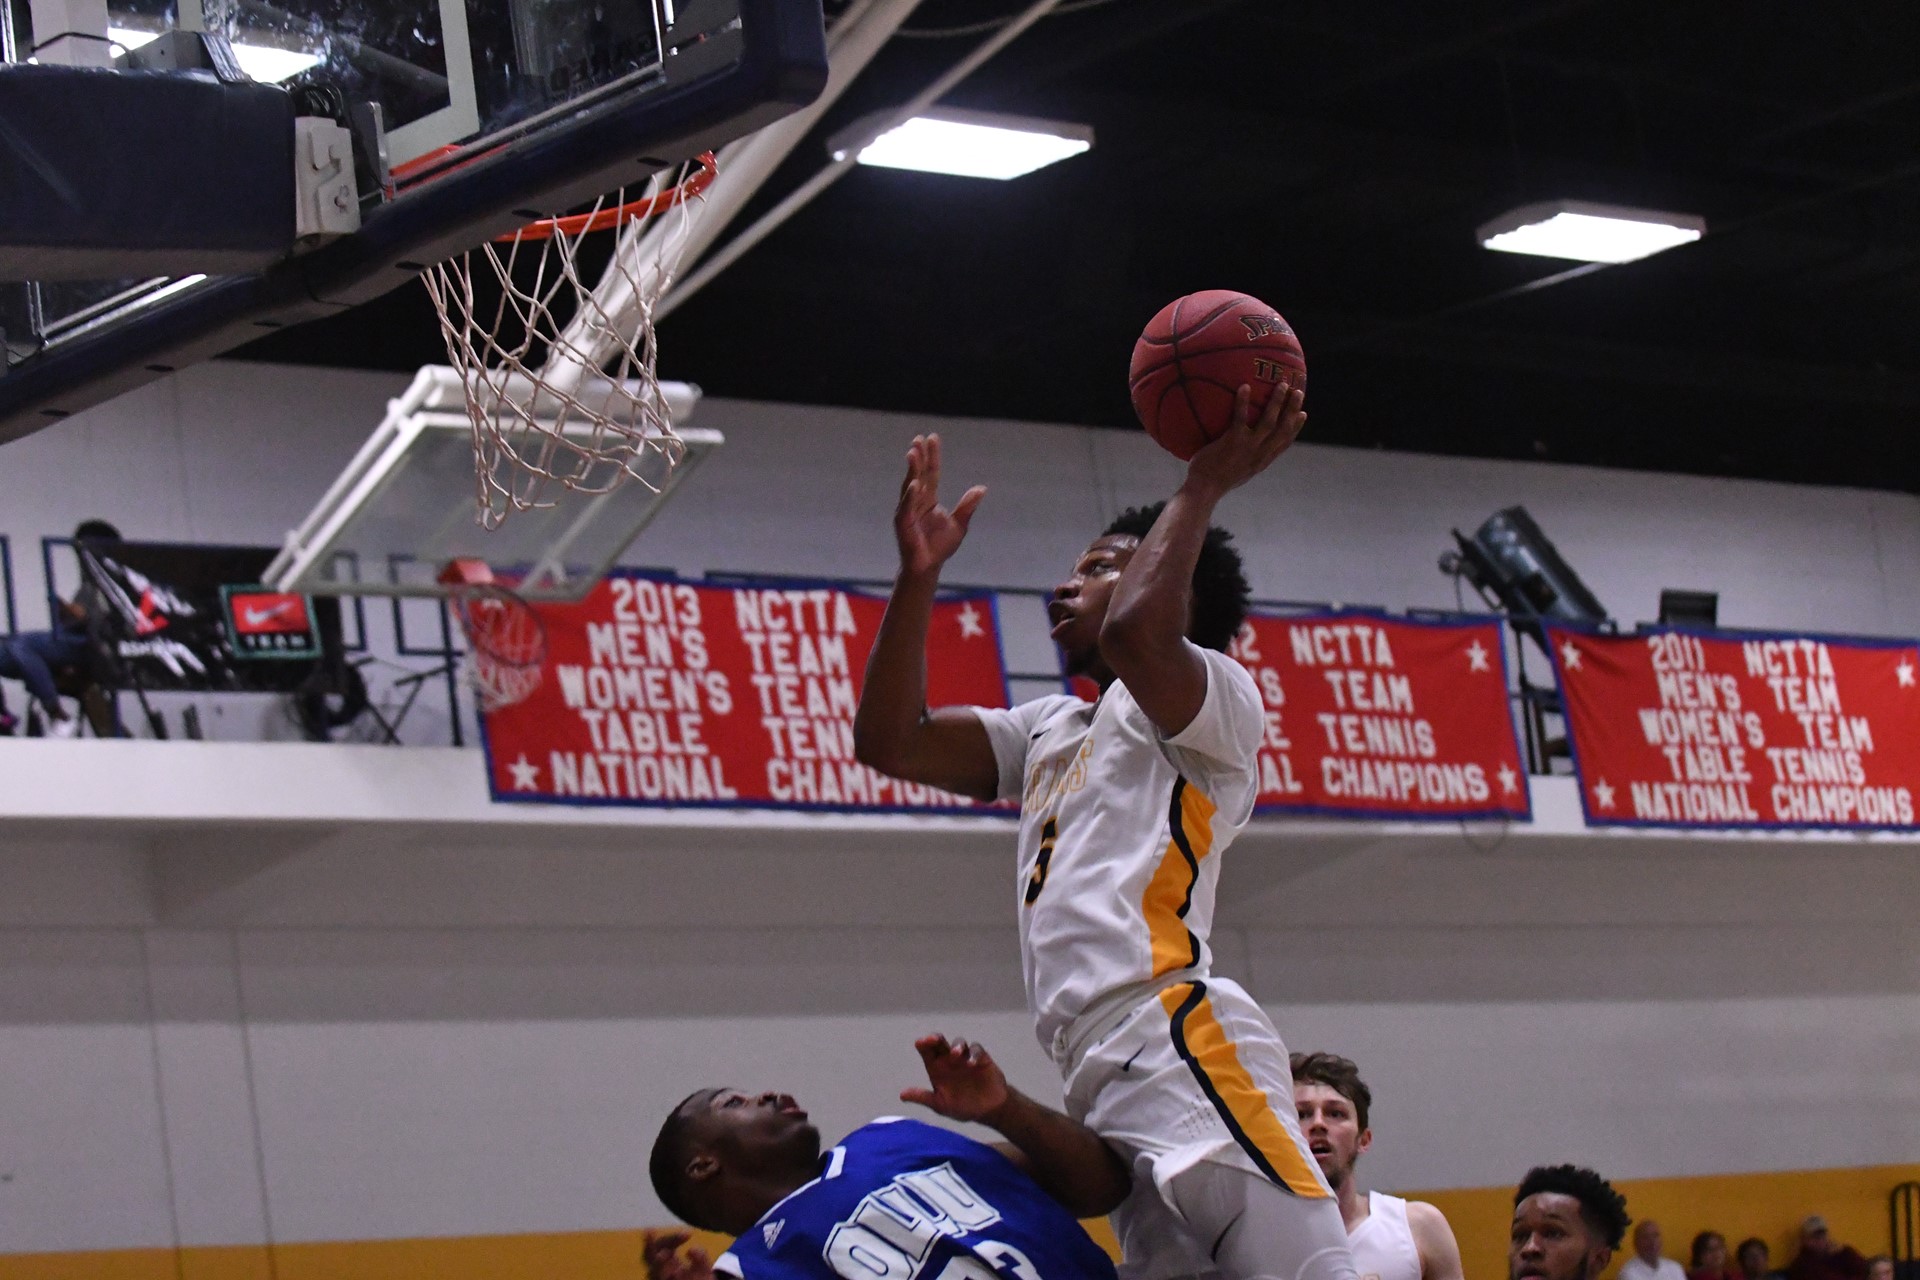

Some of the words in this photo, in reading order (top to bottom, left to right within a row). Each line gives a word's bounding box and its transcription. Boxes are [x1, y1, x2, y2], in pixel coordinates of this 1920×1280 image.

[611, 578, 700, 627] 2013
[733, 588, 857, 636] NCTTA
[587, 621, 709, 669] MEN'S
[742, 632, 850, 676] TEAM
[1289, 624, 1394, 667] NCTTA
[1647, 632, 1705, 671] 2011
[1743, 639, 1835, 678] NCTTA
[557, 663, 733, 715] WOMEN'S
[752, 673, 856, 719] TEAM
[1324, 669, 1414, 714] TEAM
[1656, 671, 1742, 711] MEN'S
[1766, 675, 1842, 713] TEAM
[579, 708, 709, 755] TABLE
[1317, 713, 1436, 758] TENNIS
[1638, 708, 1765, 748] WOMEN'S
[1798, 713, 1874, 752] TEAM
[551, 750, 738, 799] NATIONAL
[1320, 756, 1490, 803] CHAMPIONS
[1663, 746, 1752, 783] TABLE
[1766, 748, 1866, 785] TENNIS
[1631, 782, 1759, 821] NATIONAL
[1771, 783, 1914, 825] CHAMPIONS
